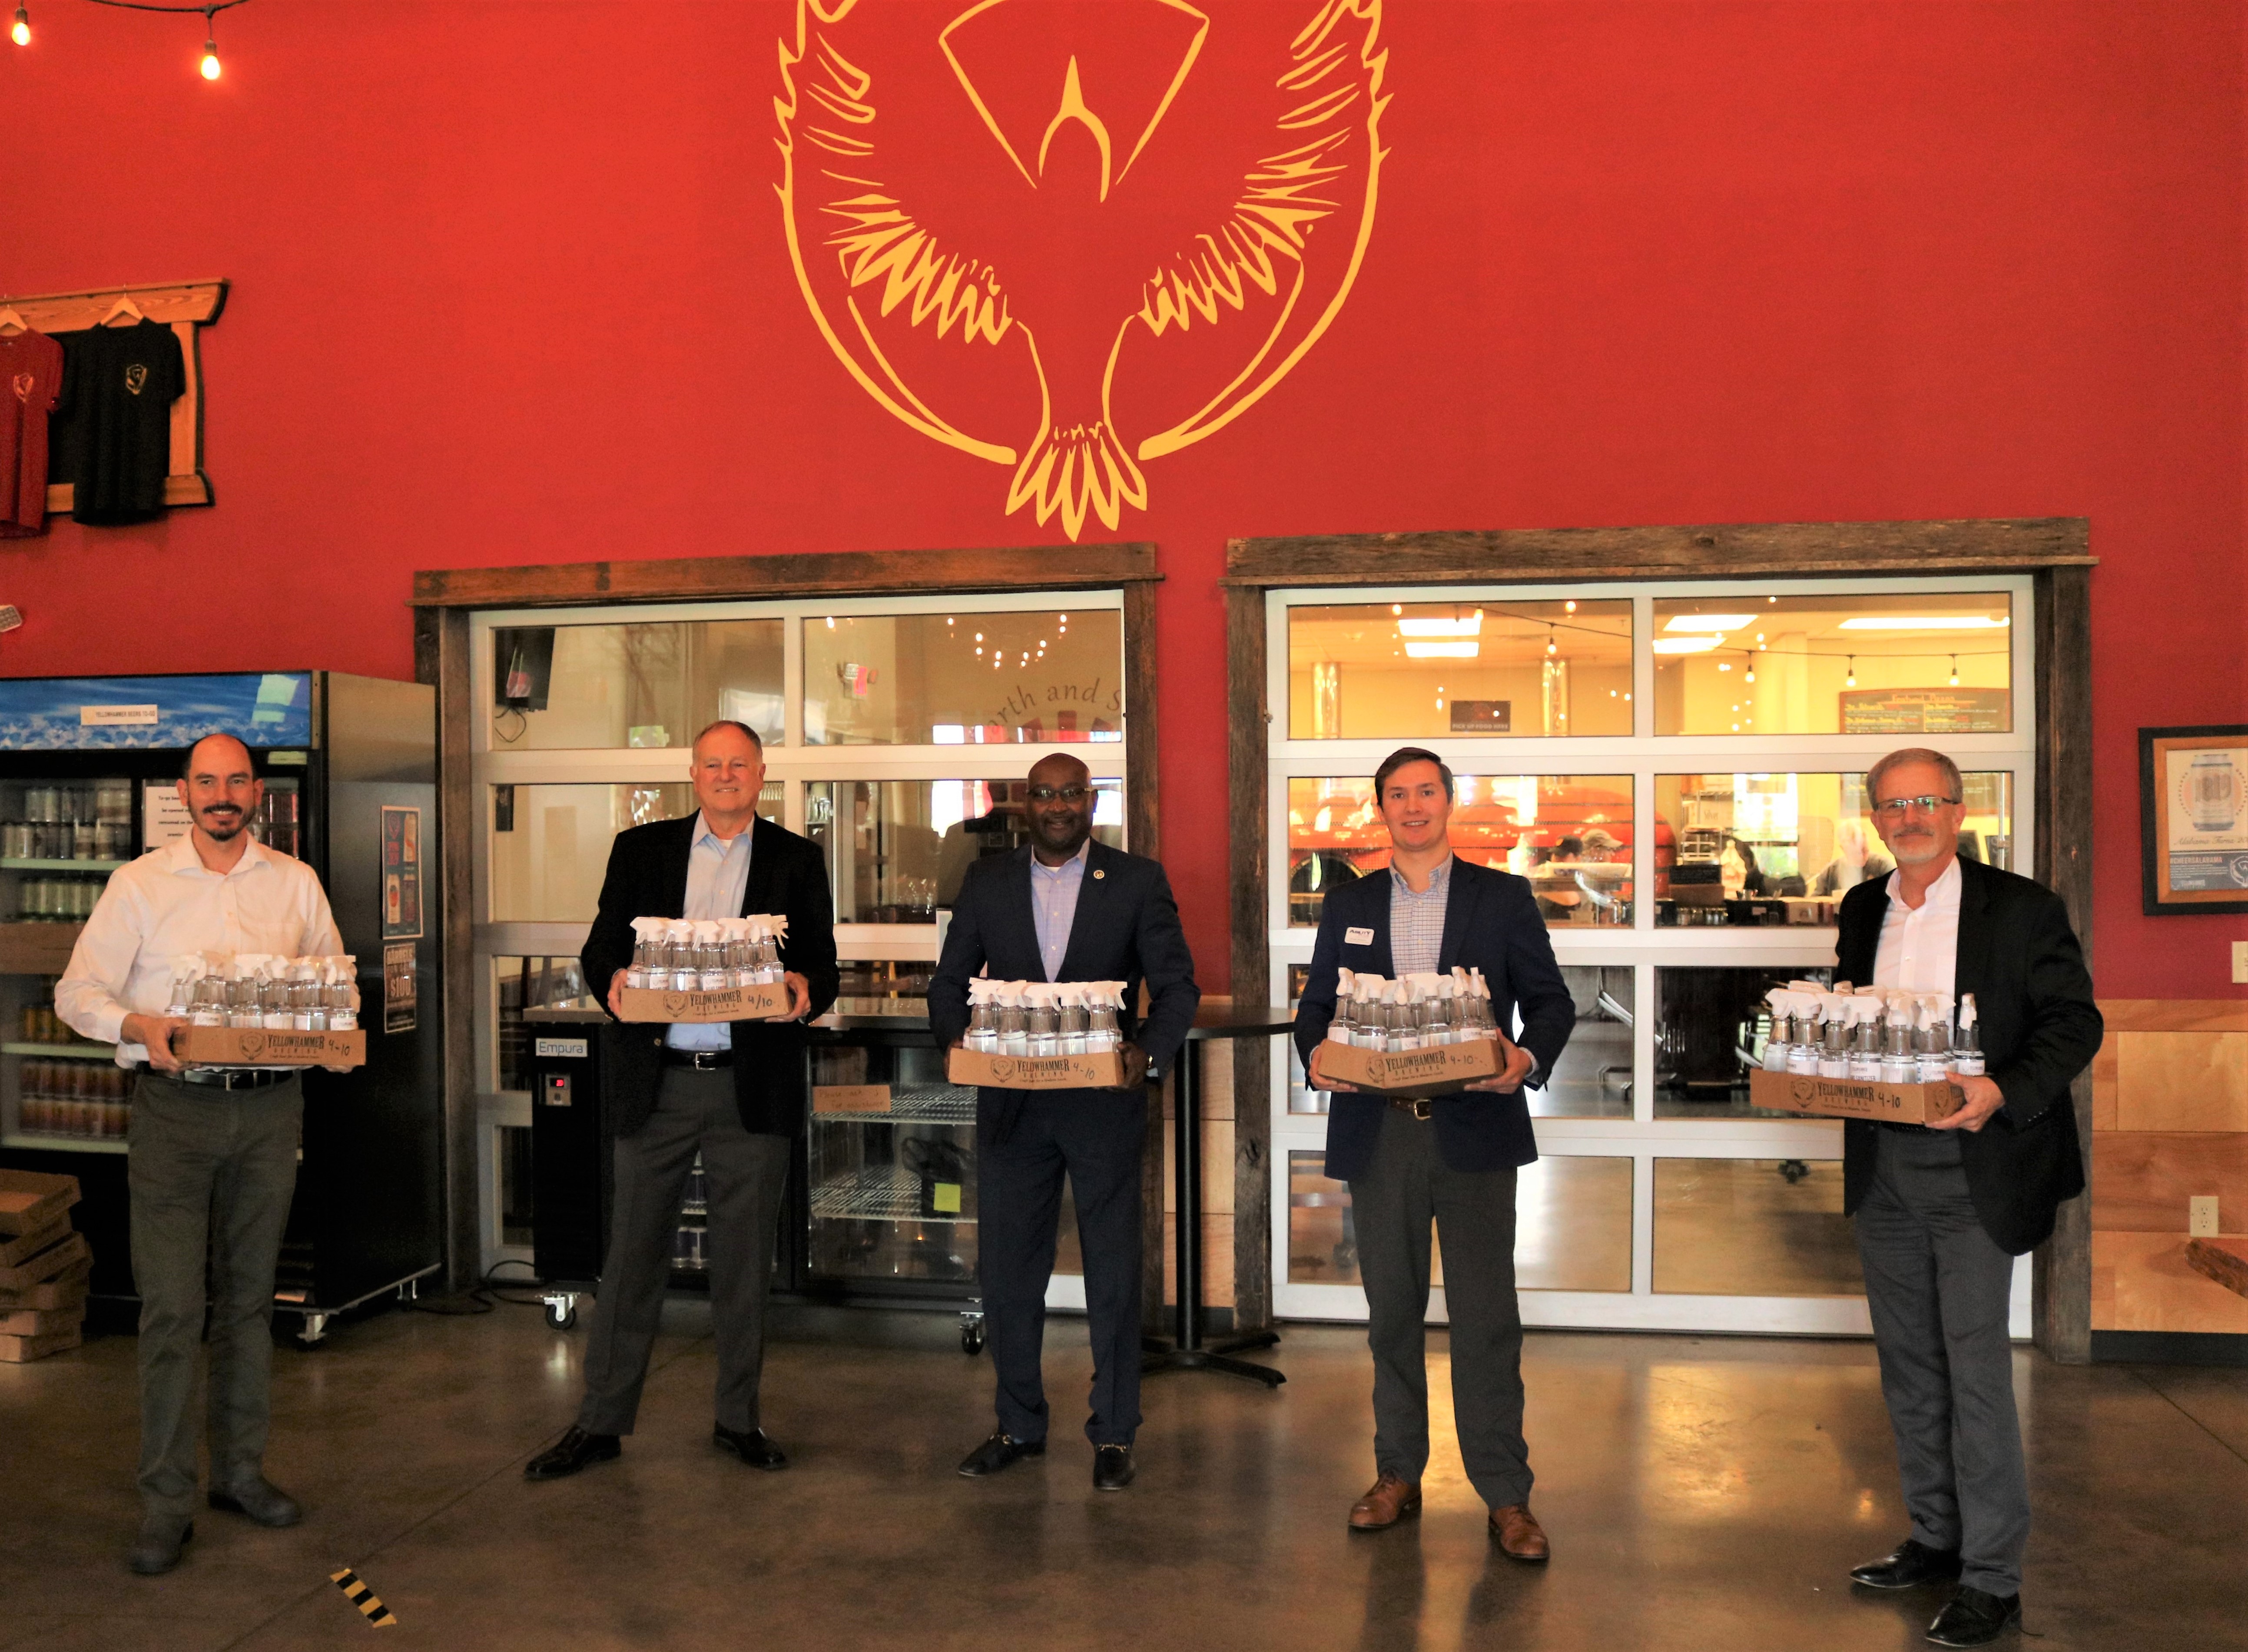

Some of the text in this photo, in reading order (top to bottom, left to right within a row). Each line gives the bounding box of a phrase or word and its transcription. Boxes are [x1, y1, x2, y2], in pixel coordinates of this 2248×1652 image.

[1048, 678, 1100, 703] and
[748, 994, 773, 1010] 4/10
[268, 1034, 325, 1049] YELLOWHAMMER
[329, 1039, 350, 1056] 4-10
[539, 1042, 583, 1056] Empura
[1386, 1050, 1446, 1072] YELLOWHAMMER
[1073, 1062, 1095, 1080] 4-10
[1818, 1082, 1874, 1102] YELLOWHAMMER
[1878, 1092, 1901, 1108] 4-10
